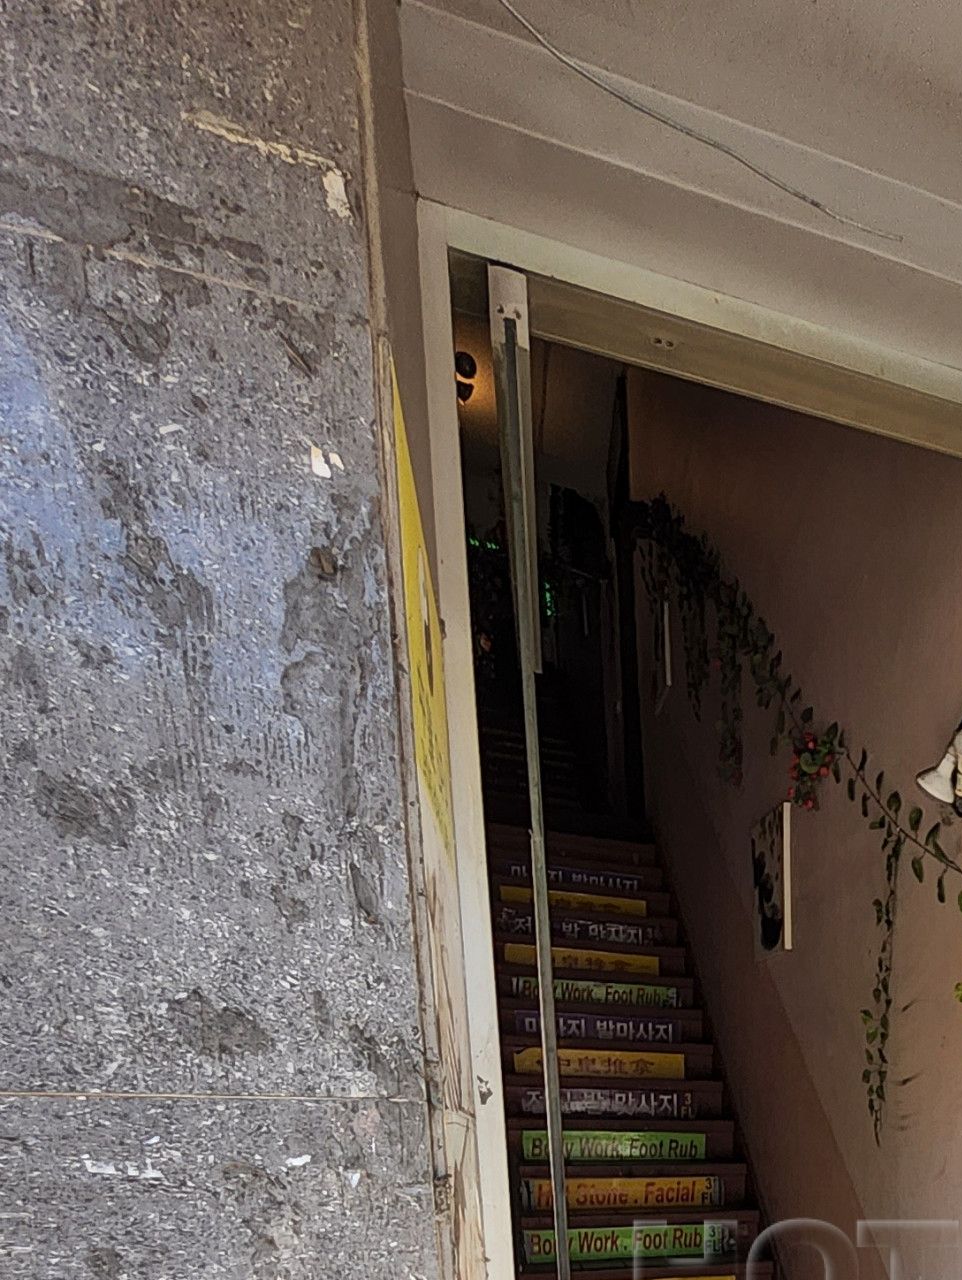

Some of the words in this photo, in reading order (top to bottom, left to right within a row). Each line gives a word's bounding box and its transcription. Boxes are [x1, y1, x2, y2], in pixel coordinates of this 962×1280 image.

[629, 1138, 664, 1159] Foot
[667, 1139, 698, 1159] Rub
[644, 1180, 696, 1204] Facial
[577, 1230, 621, 1255] Work
[634, 1228, 668, 1250] Foot
[672, 1226, 703, 1249] Rub
